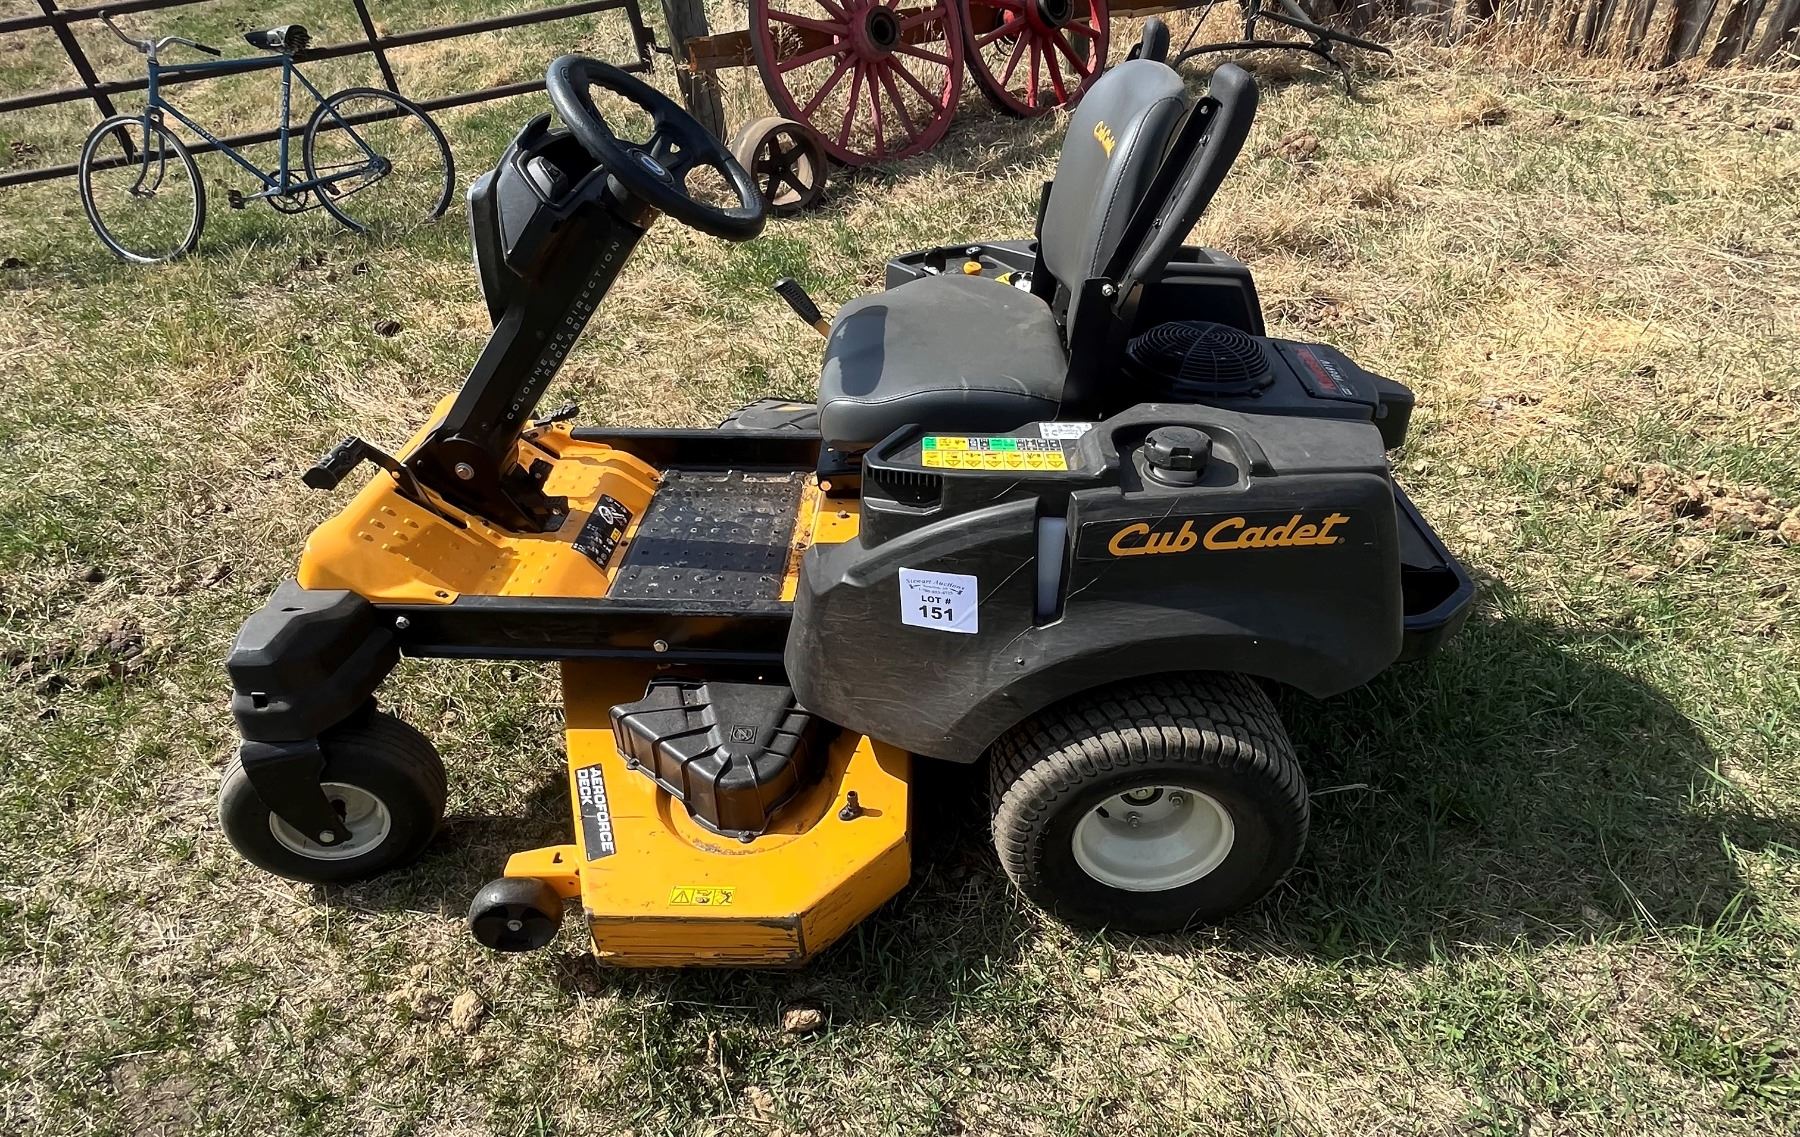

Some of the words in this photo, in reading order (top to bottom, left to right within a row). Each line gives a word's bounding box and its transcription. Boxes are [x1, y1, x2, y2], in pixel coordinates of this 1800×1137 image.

[506, 357, 548, 420] COLONNE
[550, 334, 564, 352] DE
[566, 240, 620, 326] DIRECTION
[1108, 519, 1198, 557] Cub
[1203, 512, 1350, 550] Cadet
[919, 605, 953, 621] 151
[921, 595, 942, 604] LOT
[577, 768, 594, 806] DECK
[590, 766, 615, 854] AEROFORCE
